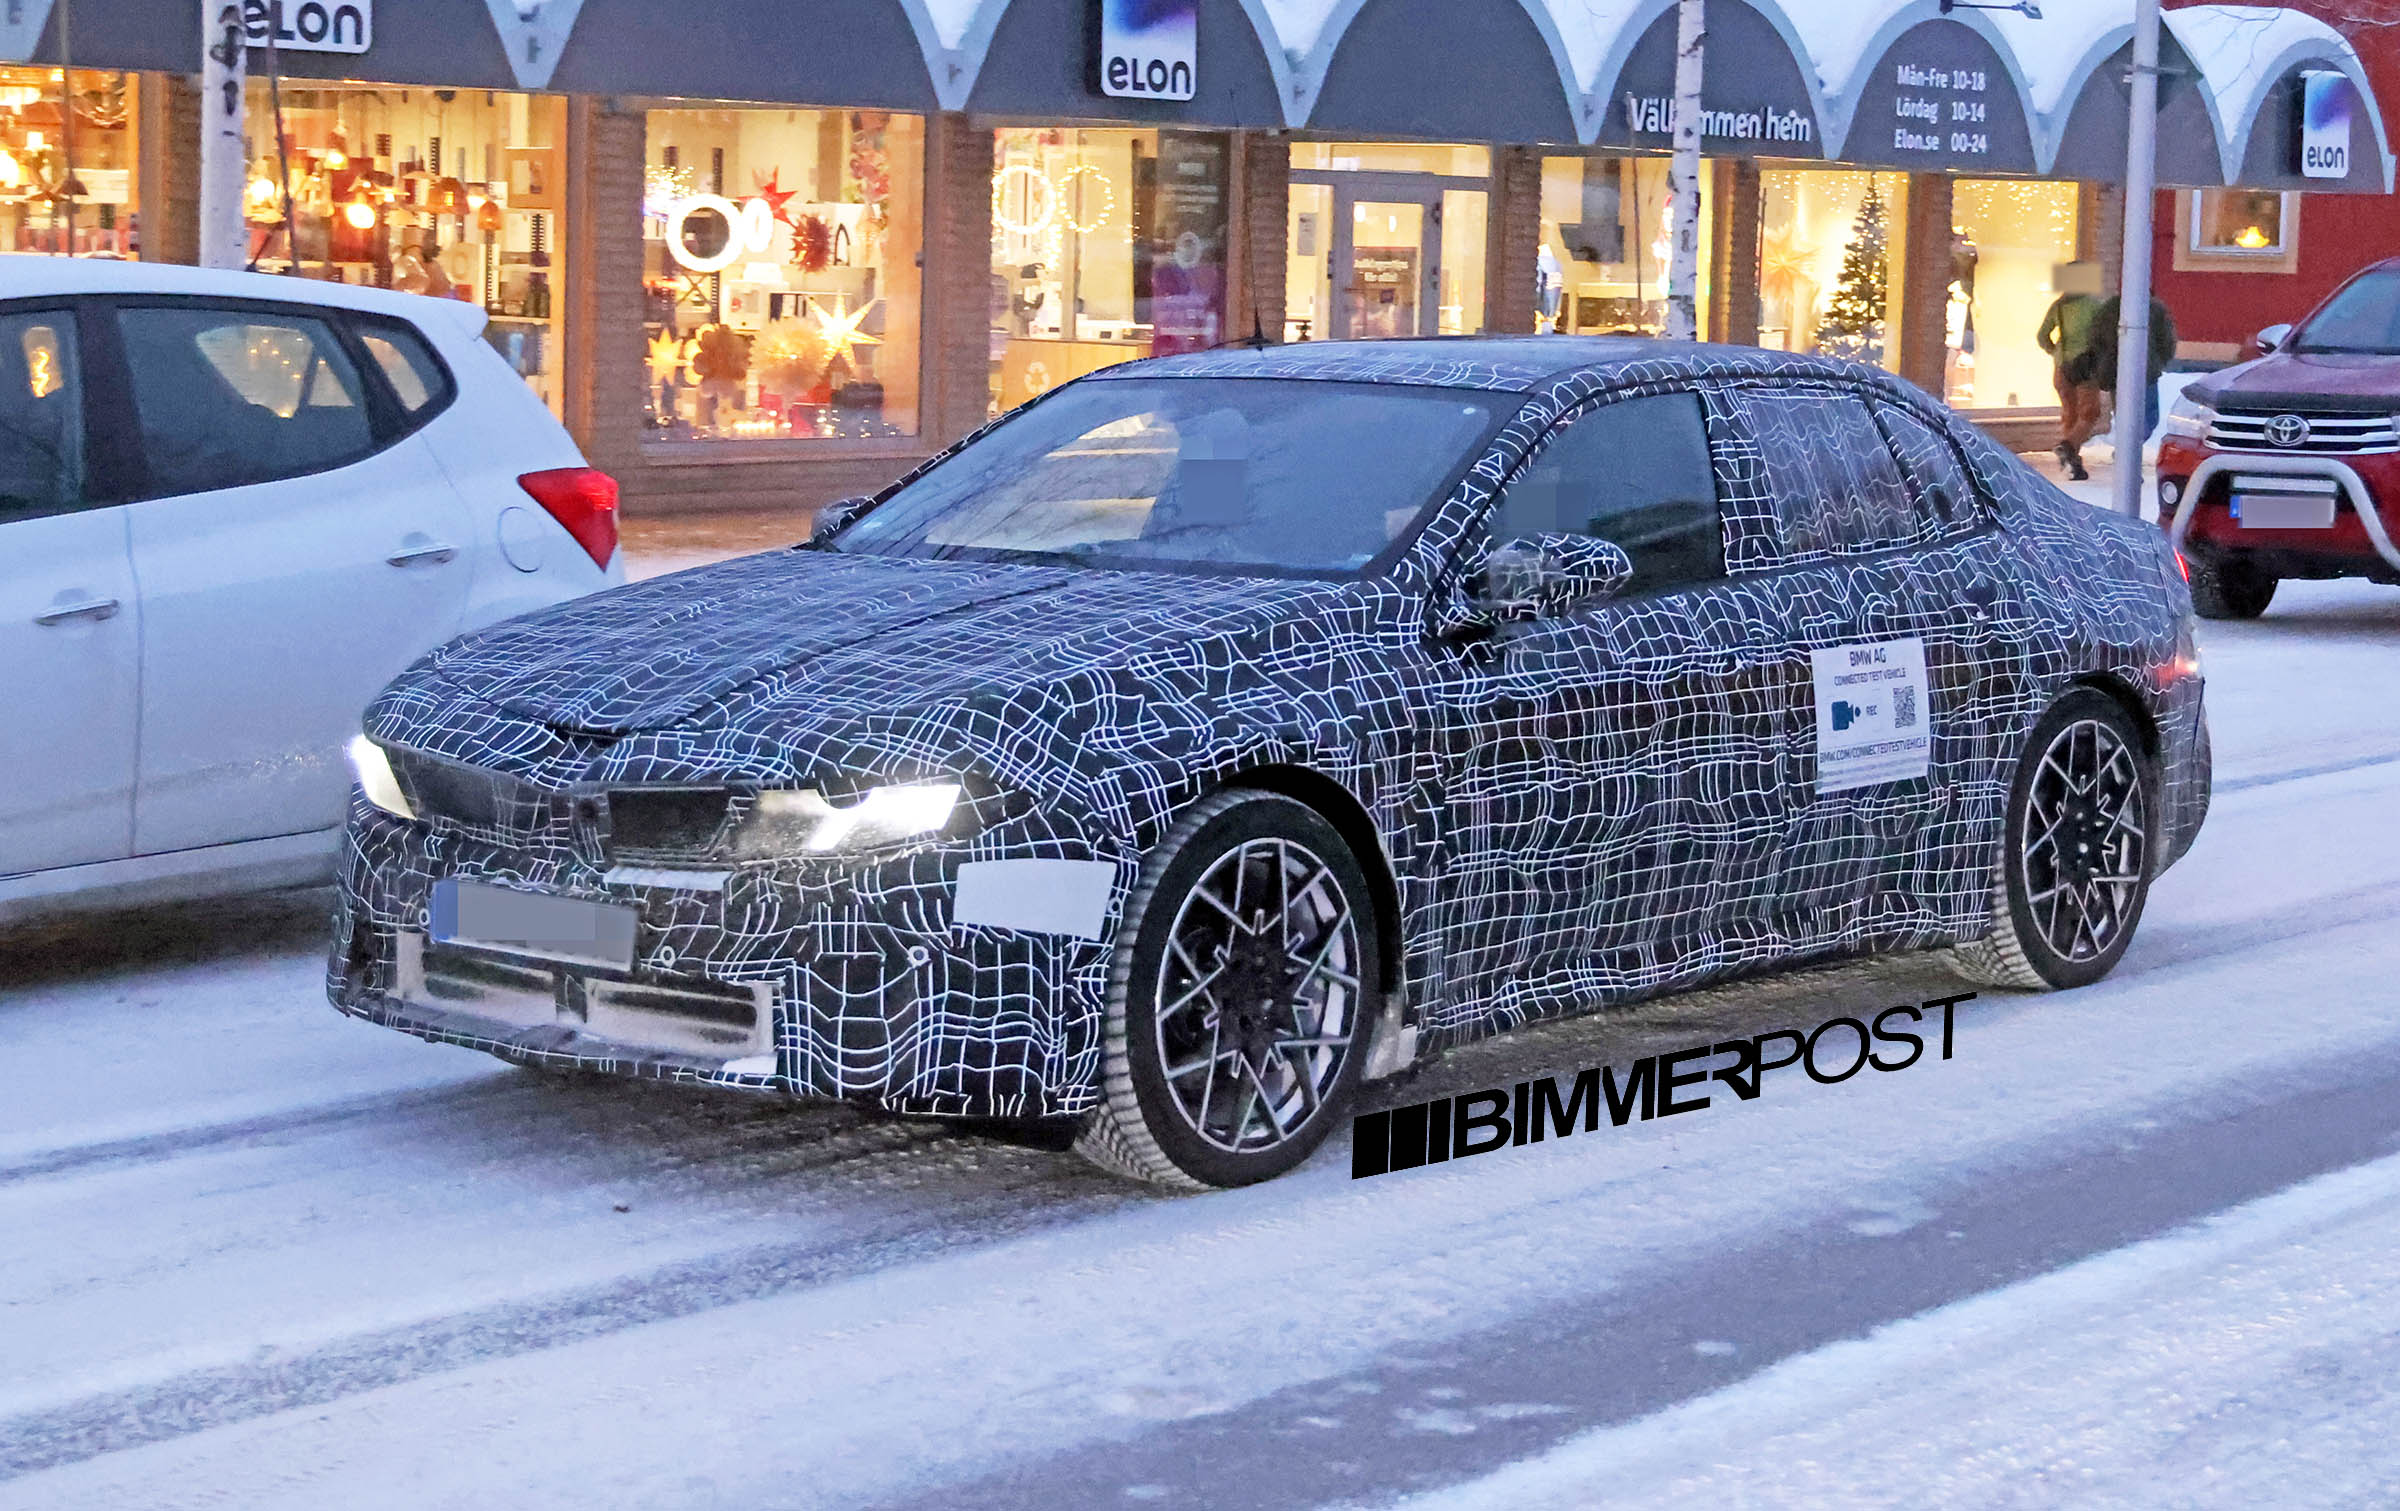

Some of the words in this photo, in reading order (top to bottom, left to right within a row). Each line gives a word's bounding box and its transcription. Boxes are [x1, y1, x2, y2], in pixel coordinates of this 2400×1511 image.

[1952, 70, 1986, 91] 10-18
[1896, 96, 1939, 125] Lördag
[1951, 101, 1985, 122] 10-14
[1766, 105, 1811, 142] hem
[1894, 128, 1940, 151] Elon.se
[1950, 132, 1987, 154] 00-24
[1849, 650, 1872, 667] BMW
[1874, 647, 1887, 664] AG
[1834, 673, 1868, 686] CONNECTED
[1868, 670, 1883, 681] TEST
[1884, 667, 1906, 679] VEHICLE
[1866, 704, 1878, 716] REC
